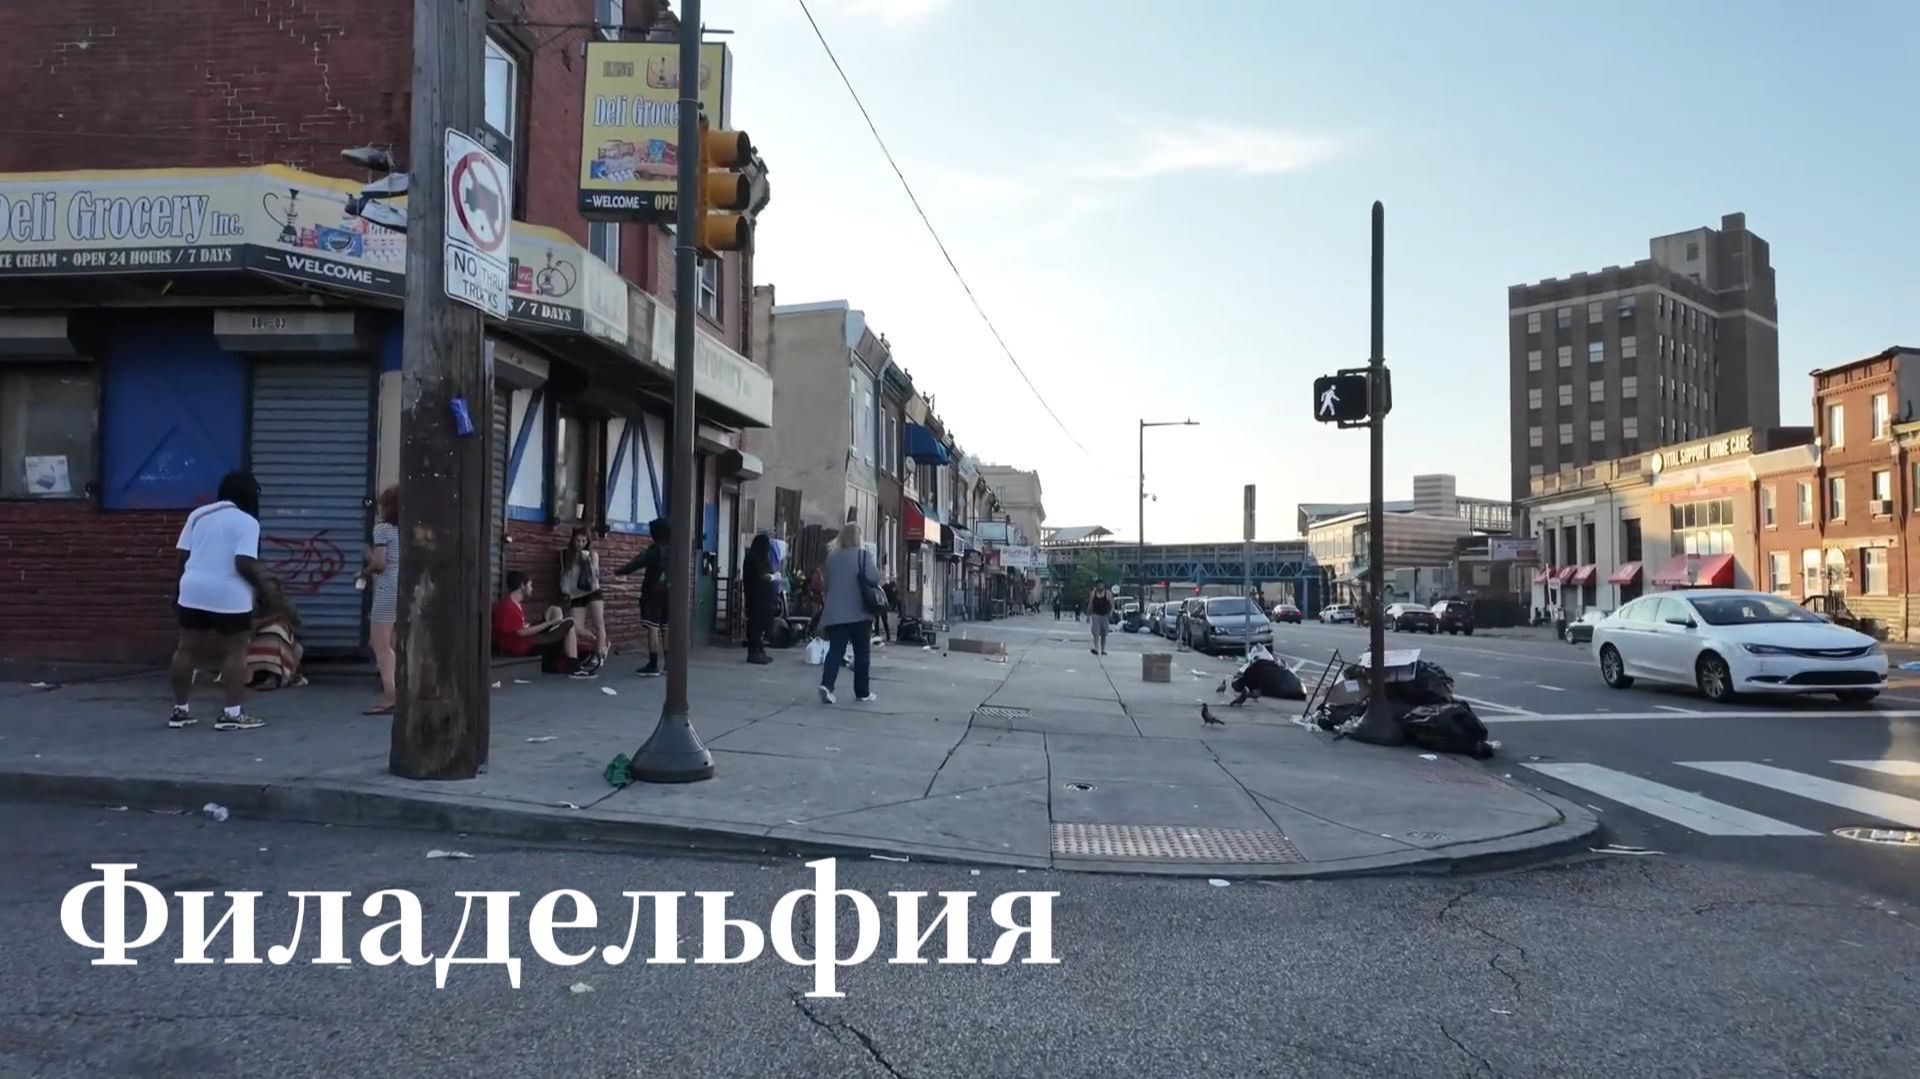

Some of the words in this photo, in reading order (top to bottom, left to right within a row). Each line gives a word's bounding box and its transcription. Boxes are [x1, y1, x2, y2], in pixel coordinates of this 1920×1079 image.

[593, 95, 628, 127] Deli
[632, 96, 679, 127] Groce
[67, 190, 210, 244] Grocery
[210, 211, 244, 237] Inc.
[592, 195, 640, 209] WELCOME
[16, 252, 57, 268] CREAM
[72, 251, 107, 267] OPEN
[109, 251, 126, 266] 24
[130, 249, 172, 265] HOURS
[188, 249, 197, 262] 7
[200, 247, 232, 263] DAYS
[285, 254, 373, 284] WELCOME
[454, 251, 478, 277] NO
[481, 268, 504, 292] THRU
[530, 303, 538, 316] 7
[541, 304, 572, 322] DAYS
[1663, 450, 1680, 470] VITAL
[1680, 443, 1708, 465] SUPPORT
[1709, 437, 1730, 458] HOME
[1730, 433, 1750, 454] CARE
